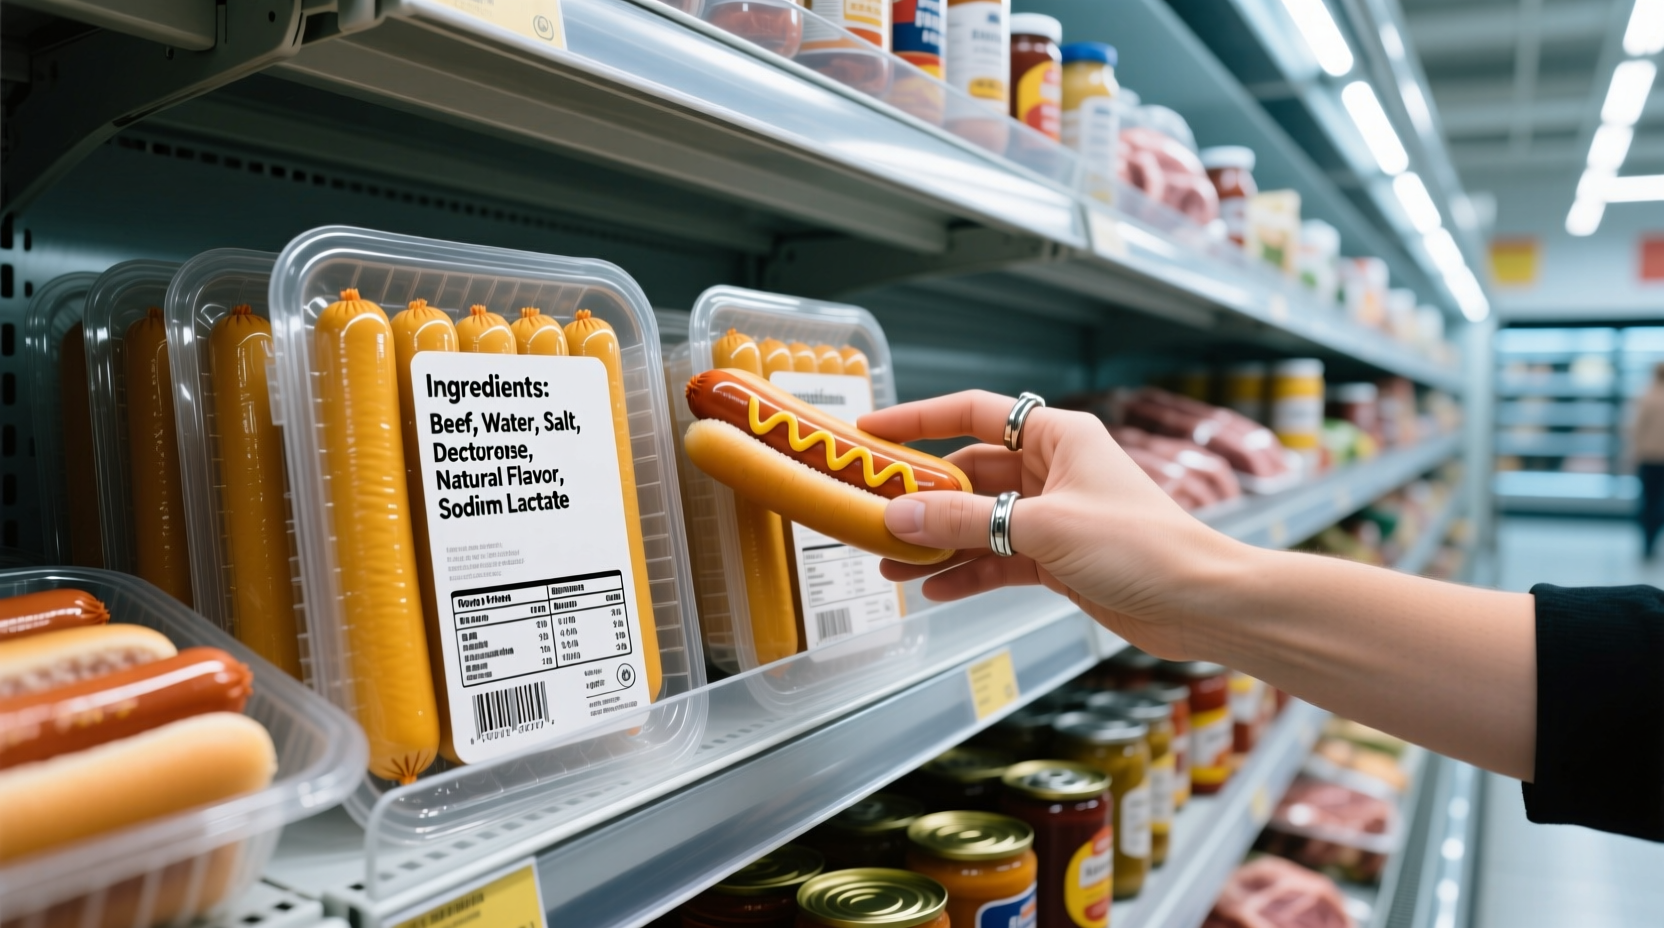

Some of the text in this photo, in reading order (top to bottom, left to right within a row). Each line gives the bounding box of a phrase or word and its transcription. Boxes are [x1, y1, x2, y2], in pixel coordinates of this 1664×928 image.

[426, 373, 550, 404] Ingredients:
[430, 410, 581, 437] Beef, Water, Salt,
[436, 465, 565, 490] Natural Flavor,
[506, 491, 570, 514] Lactate
